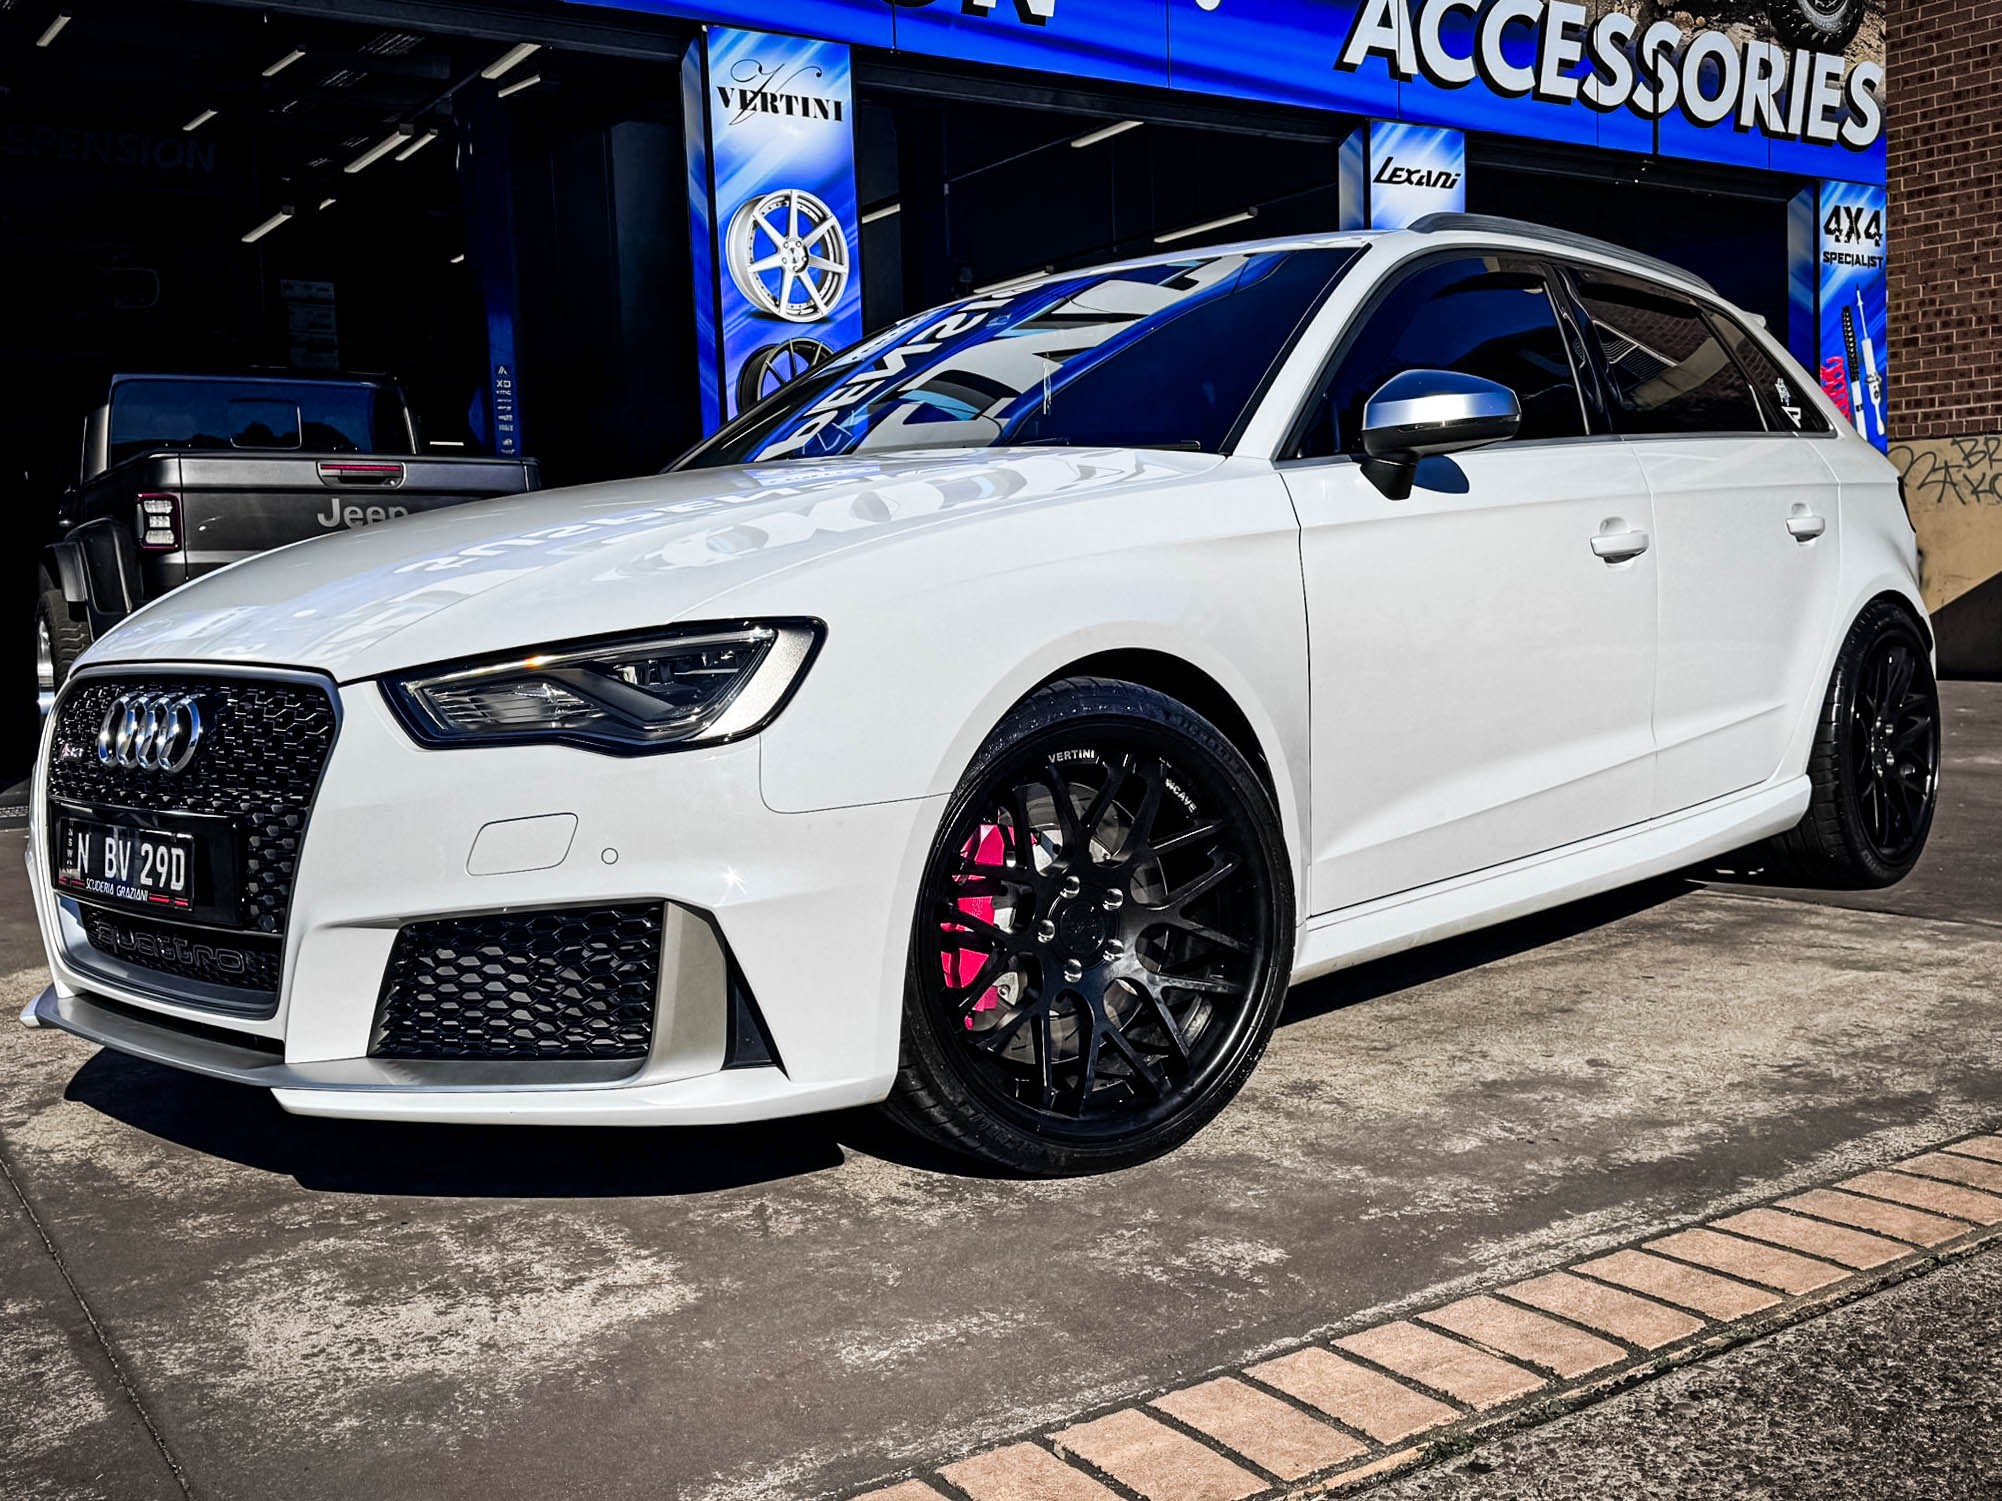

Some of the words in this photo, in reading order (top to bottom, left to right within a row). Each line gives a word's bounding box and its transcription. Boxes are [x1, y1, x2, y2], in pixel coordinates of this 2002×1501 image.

[1338, 0, 1885, 146] ACCESSORIES
[716, 86, 843, 122] VERTINI
[1823, 205, 1884, 247] 4X4
[1822, 251, 1884, 270] SPECIALIST
[1048, 749, 1096, 764] VERTINI
[104, 836, 132, 882] BV
[139, 842, 186, 891] 29D
[85, 878, 114, 896] SCUDERIA
[116, 884, 149, 903] GRAZIANI
[95, 922, 247, 974] quattro
